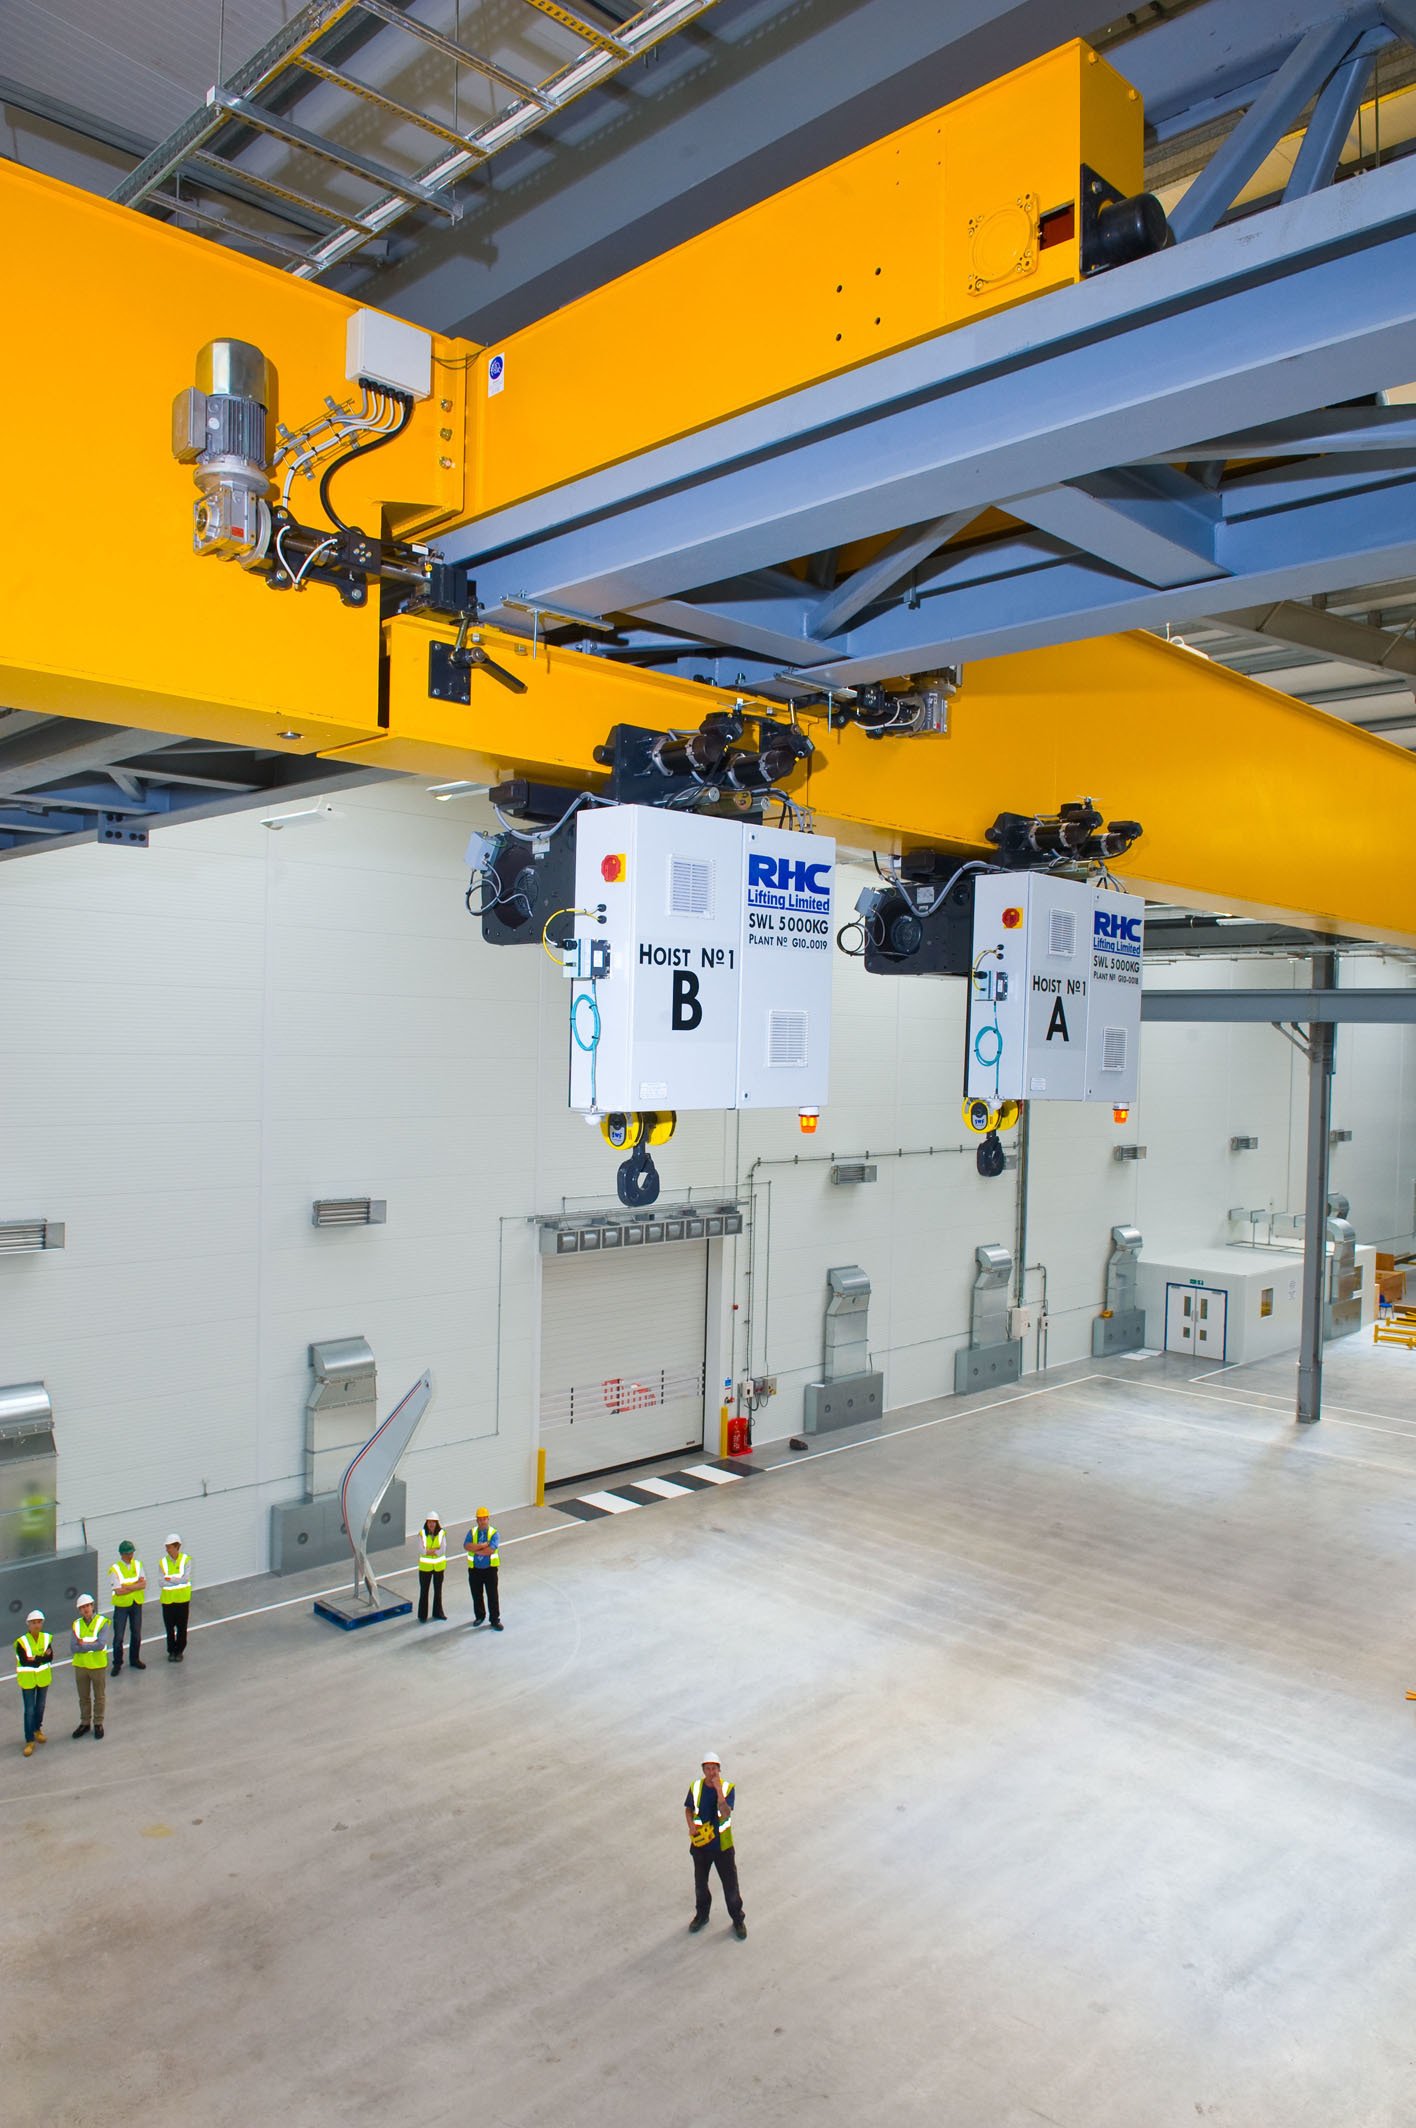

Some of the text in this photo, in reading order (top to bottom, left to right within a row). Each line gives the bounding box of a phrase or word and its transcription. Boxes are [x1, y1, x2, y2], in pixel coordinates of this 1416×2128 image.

[748, 853, 832, 895] RHC
[748, 889, 830, 912] Lifting Limited
[749, 913, 774, 930] SWL
[1094, 910, 1142, 943] RHC
[749, 933, 774, 946] PLANT
[1093, 937, 1141, 955] Lifting Limited
[640, 943, 691, 967] HOIST
[1093, 955, 1109, 969] SWL
[1032, 975, 1062, 993] HOIST
[1093, 971, 1108, 980] PLANT
[672, 970, 703, 1031] B
[1046, 996, 1070, 1042] A
